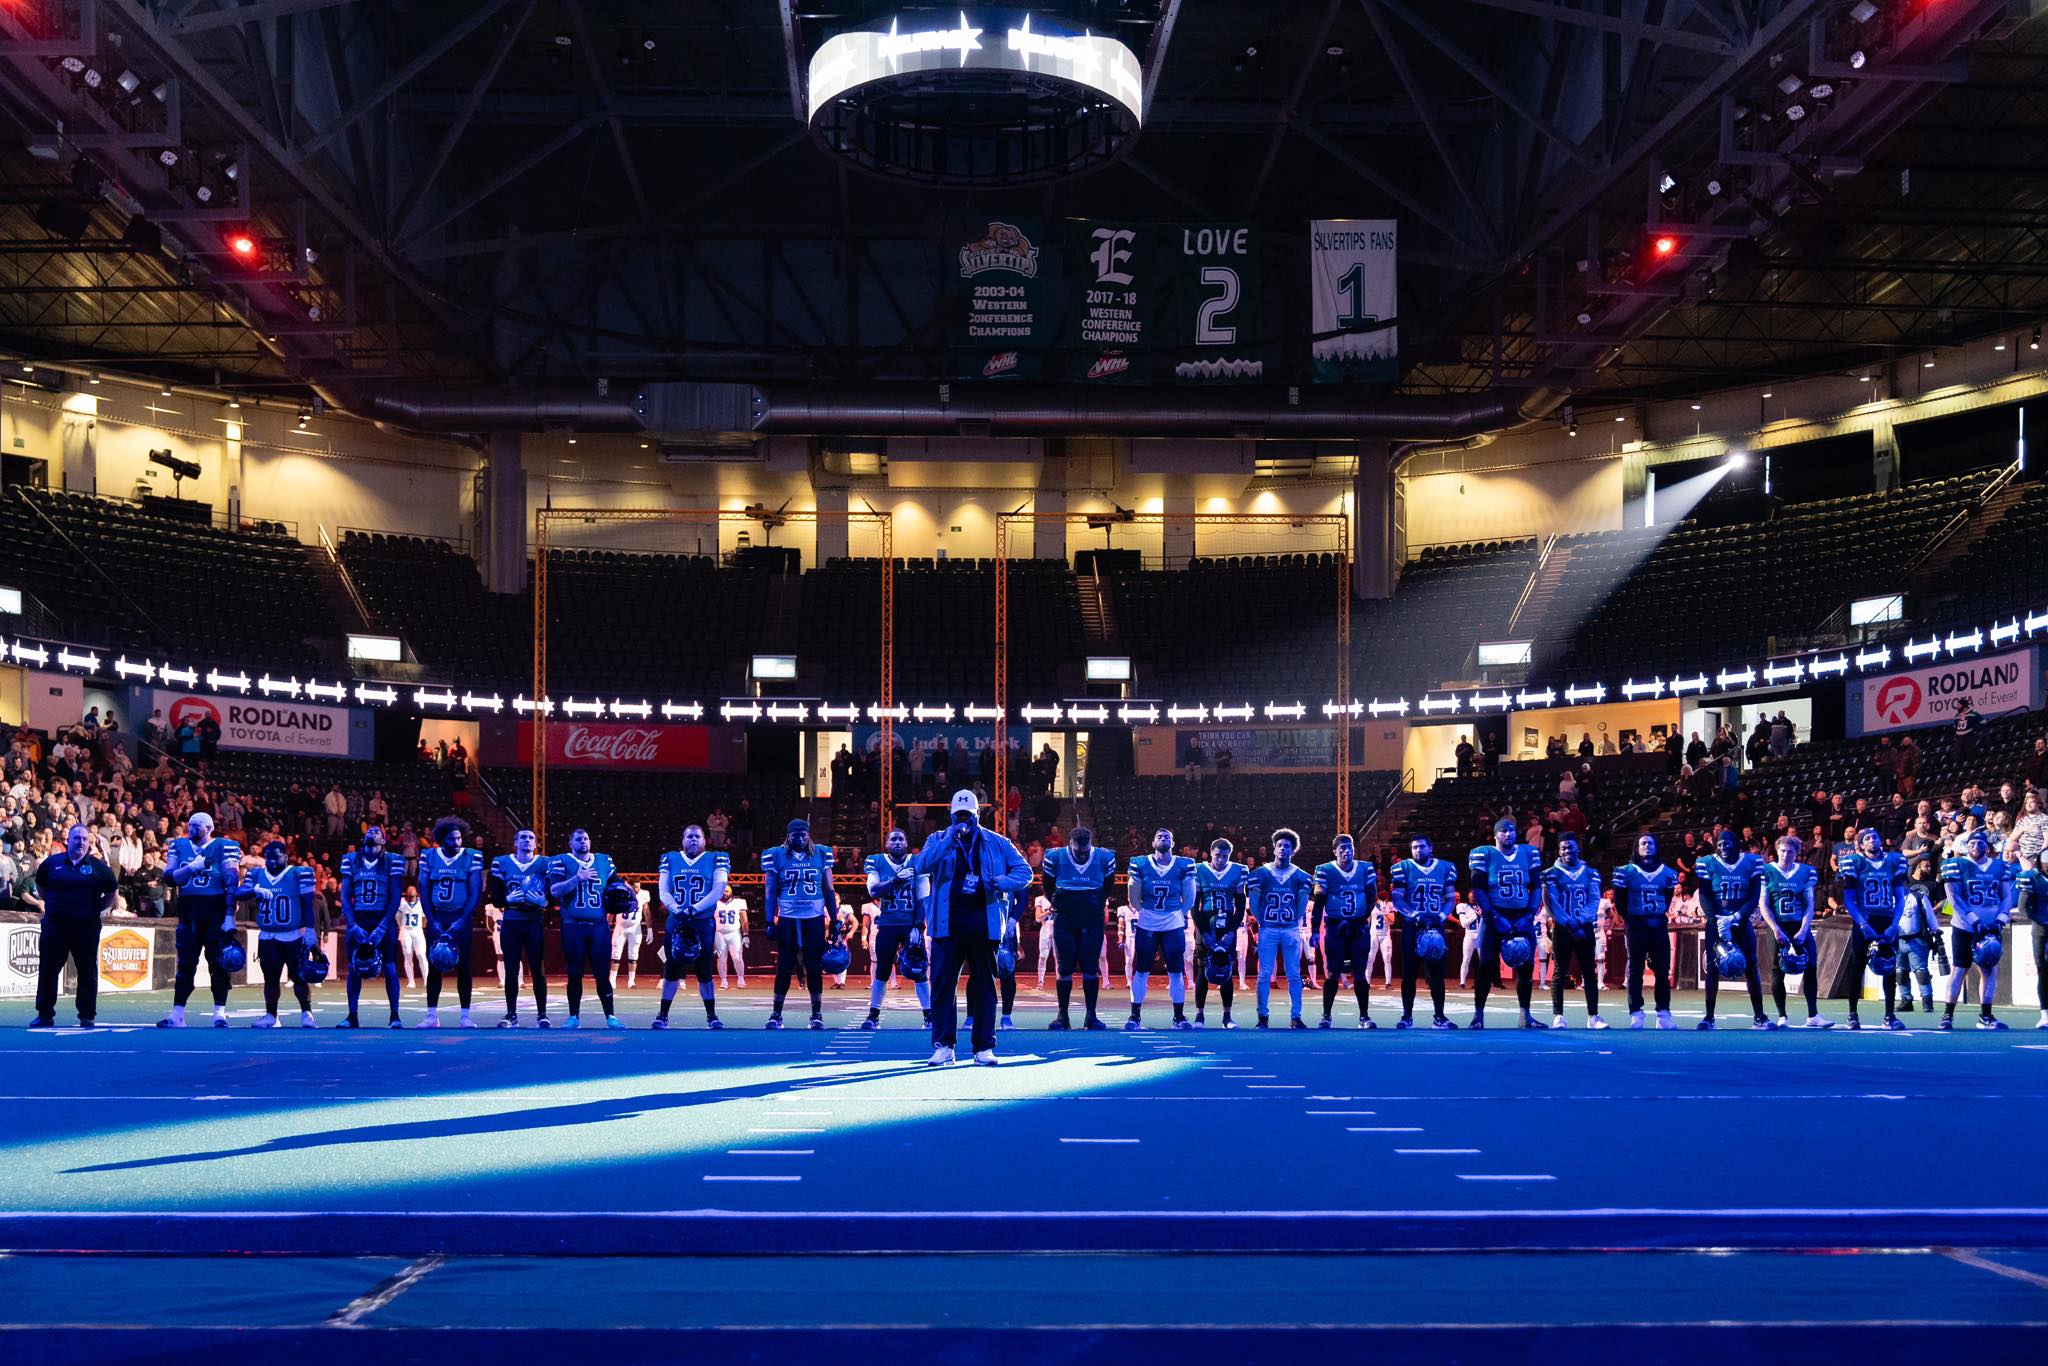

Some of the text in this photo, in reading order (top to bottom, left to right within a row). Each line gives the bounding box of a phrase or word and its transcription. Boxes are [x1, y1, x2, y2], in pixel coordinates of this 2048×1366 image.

[1183, 229, 1248, 255] LOVE
[1314, 232, 1394, 250] SILVERTIPS FANS
[1089, 228, 1136, 285] E
[974, 287, 1025, 297] 2003-04
[1087, 290, 1114, 304] 2017
[1123, 291, 1137, 305] 18
[1196, 266, 1240, 345] 2
[1337, 263, 1378, 330] 1
[1081, 320, 1141, 331] CONFERENCE
[1090, 308, 1132, 319] WESTERN
[1082, 330, 1138, 342] CHAMPIONS
[1928, 662, 2019, 696] RODLAND
[1978, 693, 1988, 706] of
[229, 706, 333, 731] RODLAND
[229, 727, 281, 742] TOYOTA
[285, 735, 295, 744] of
[361, 877, 379, 906] 8
[437, 874, 456, 902] 9
[575, 878, 602, 909] 15
[673, 874, 705, 906] 52
[785, 868, 818, 896] 75
[1497, 869, 1525, 899] 51
[1720, 881, 1741, 901] 11
[1863, 877, 1890, 909] 21
[1967, 879, 2000, 910] 54
[259, 893, 292, 926] 40
[1153, 885, 1170, 911] 7
[1264, 892, 1295, 924] 23
[1340, 889, 1358, 918] 3
[1411, 883, 1443, 914] 45
[1563, 888, 1587, 920] 13
[1641, 888, 1659, 913] 5
[1779, 887, 1796, 916] 2
[405, 913, 419, 926] 13
[718, 910, 735, 925] 56
[1375, 914, 1385, 930] 3
